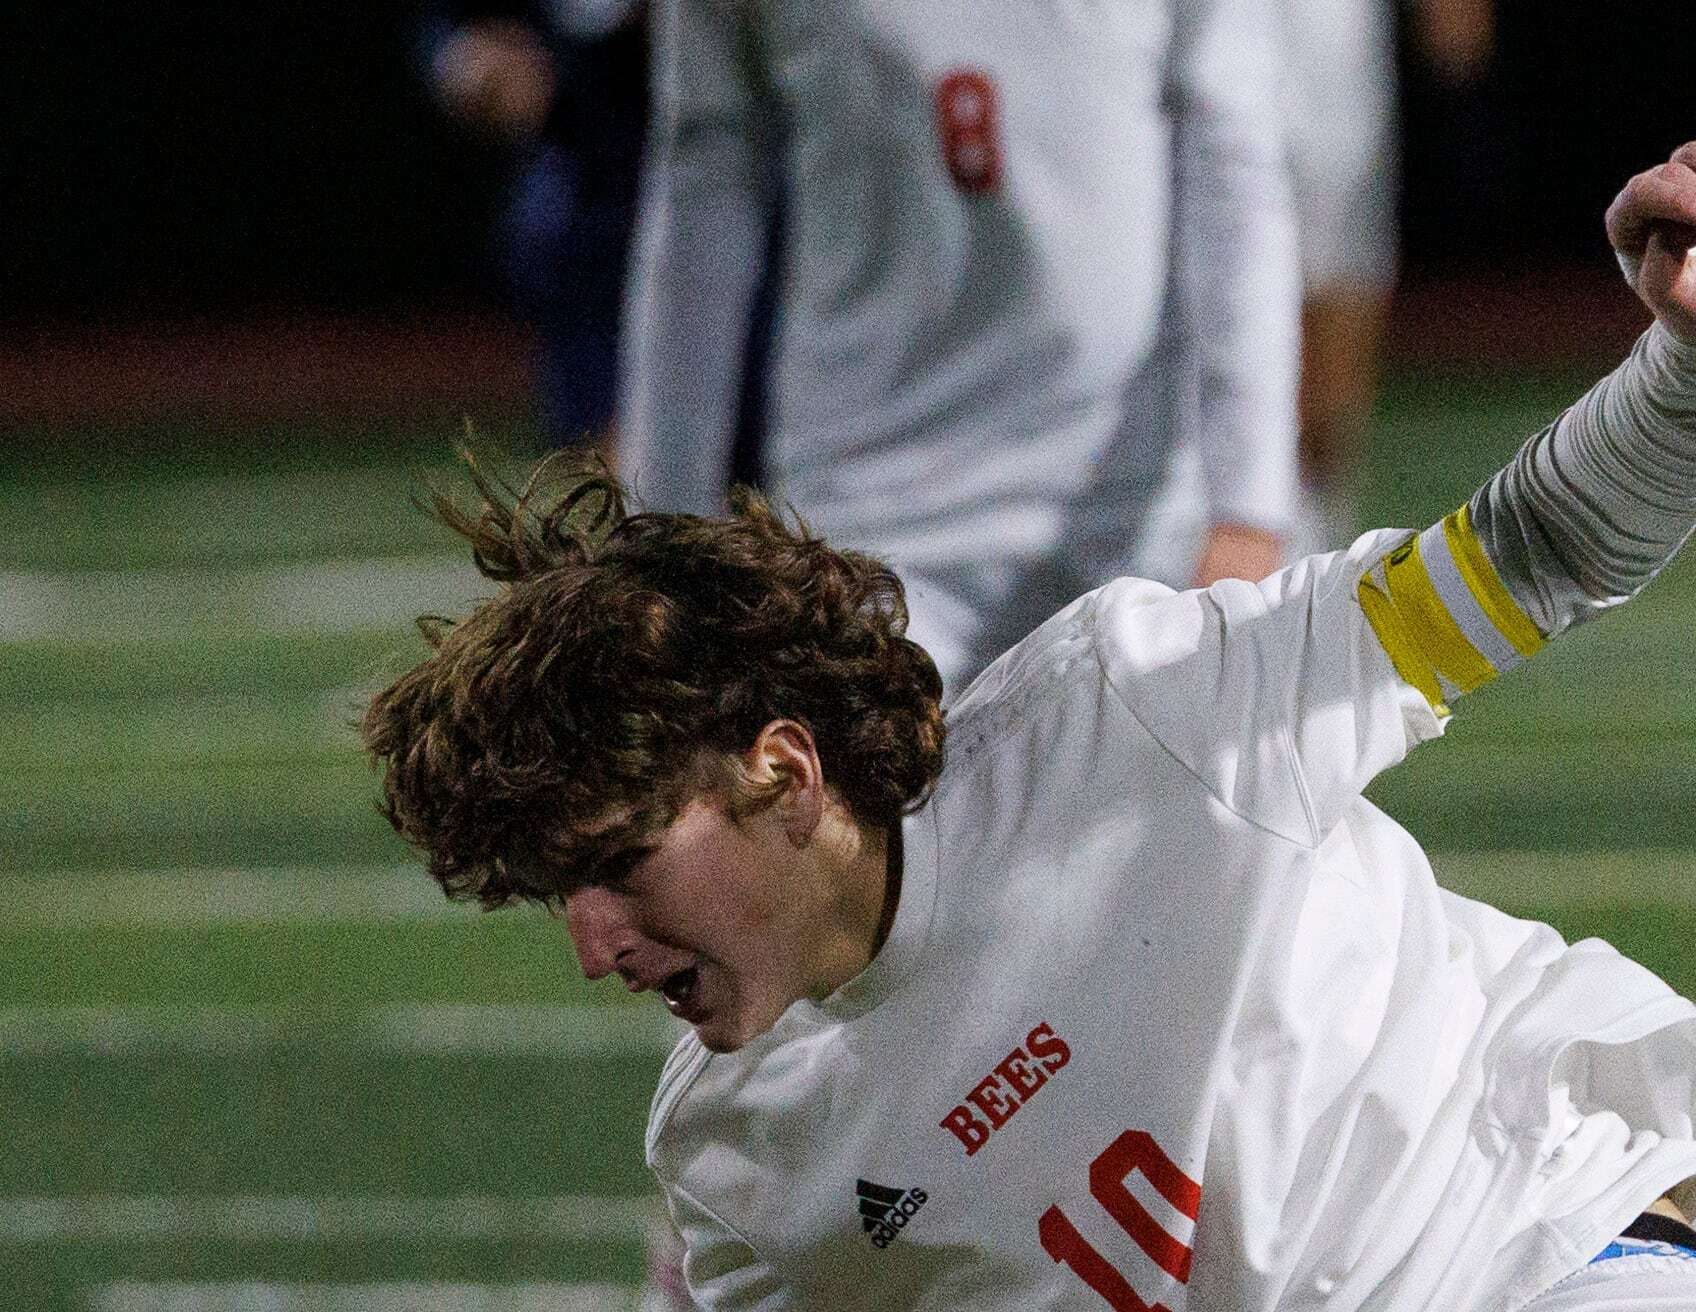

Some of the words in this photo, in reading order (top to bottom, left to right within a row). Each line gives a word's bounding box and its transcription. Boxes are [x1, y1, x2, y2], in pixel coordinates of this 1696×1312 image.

[934, 70, 1002, 195] 8
[939, 1021, 1072, 1157] BEES
[871, 1186, 928, 1249] adidas
